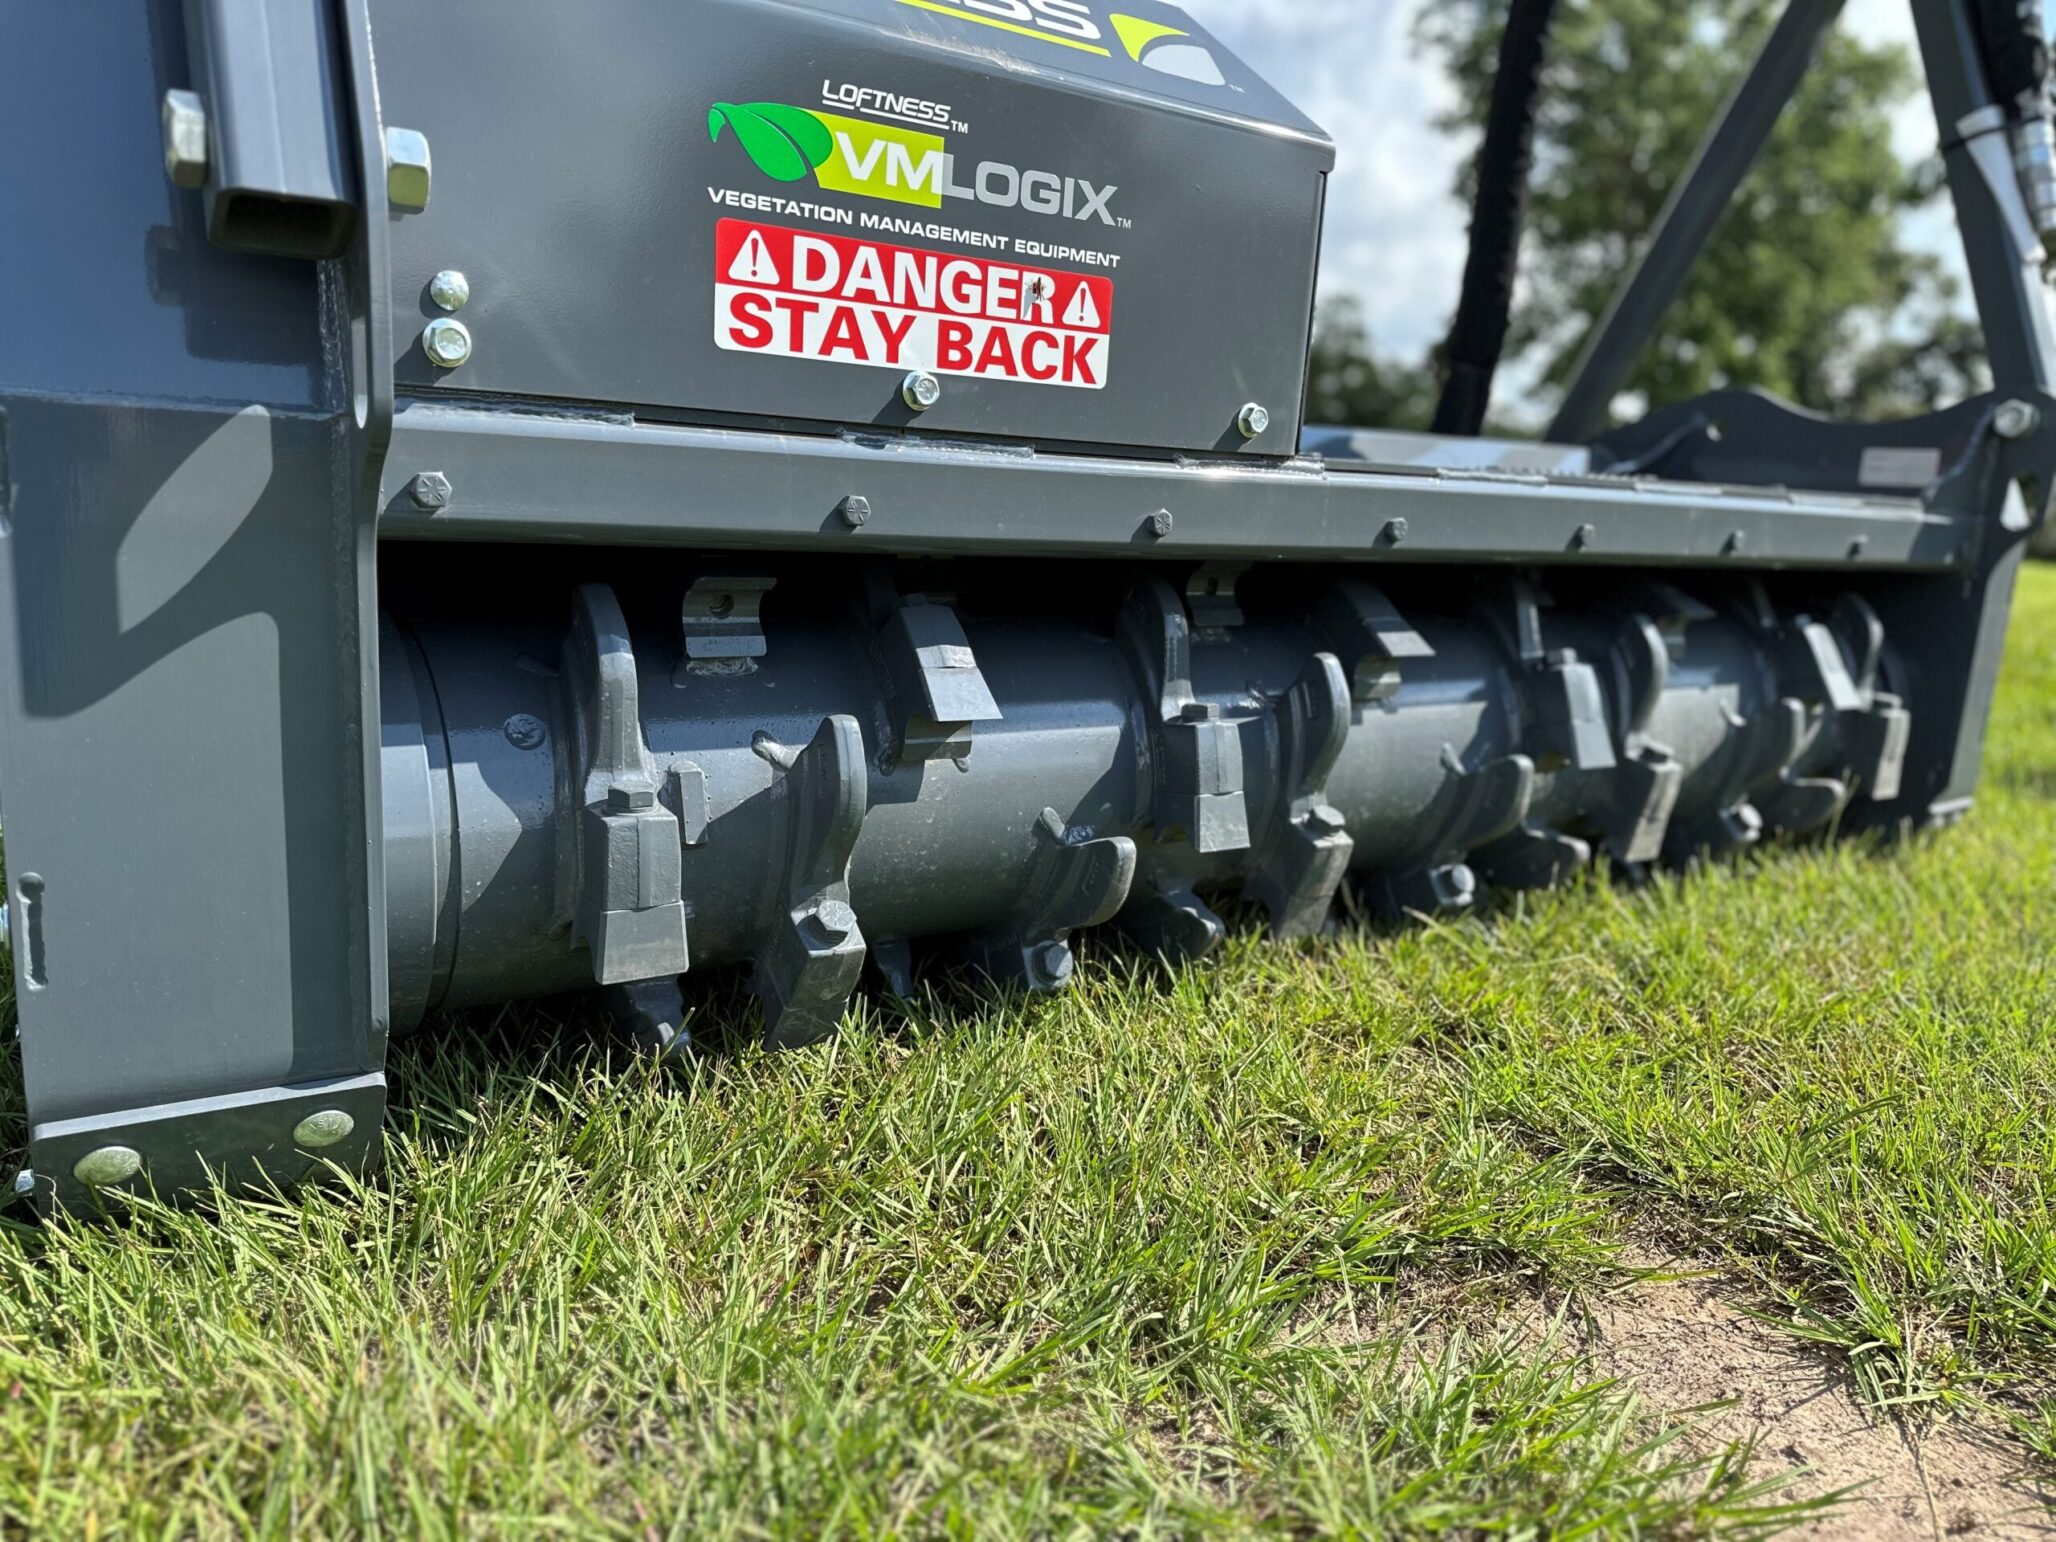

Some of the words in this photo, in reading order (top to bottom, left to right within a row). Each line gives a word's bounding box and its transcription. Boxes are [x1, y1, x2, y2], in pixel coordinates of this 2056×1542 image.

[821, 79, 952, 123] LOFTNESS
[707, 186, 854, 225] VEGETATION
[859, 213, 1009, 251] MANAGEMENT
[1014, 238, 1120, 268] EQUIPMENT
[792, 234, 1055, 324] DANGER
[729, 292, 916, 364] STAY
[936, 319, 1099, 384] BACK
